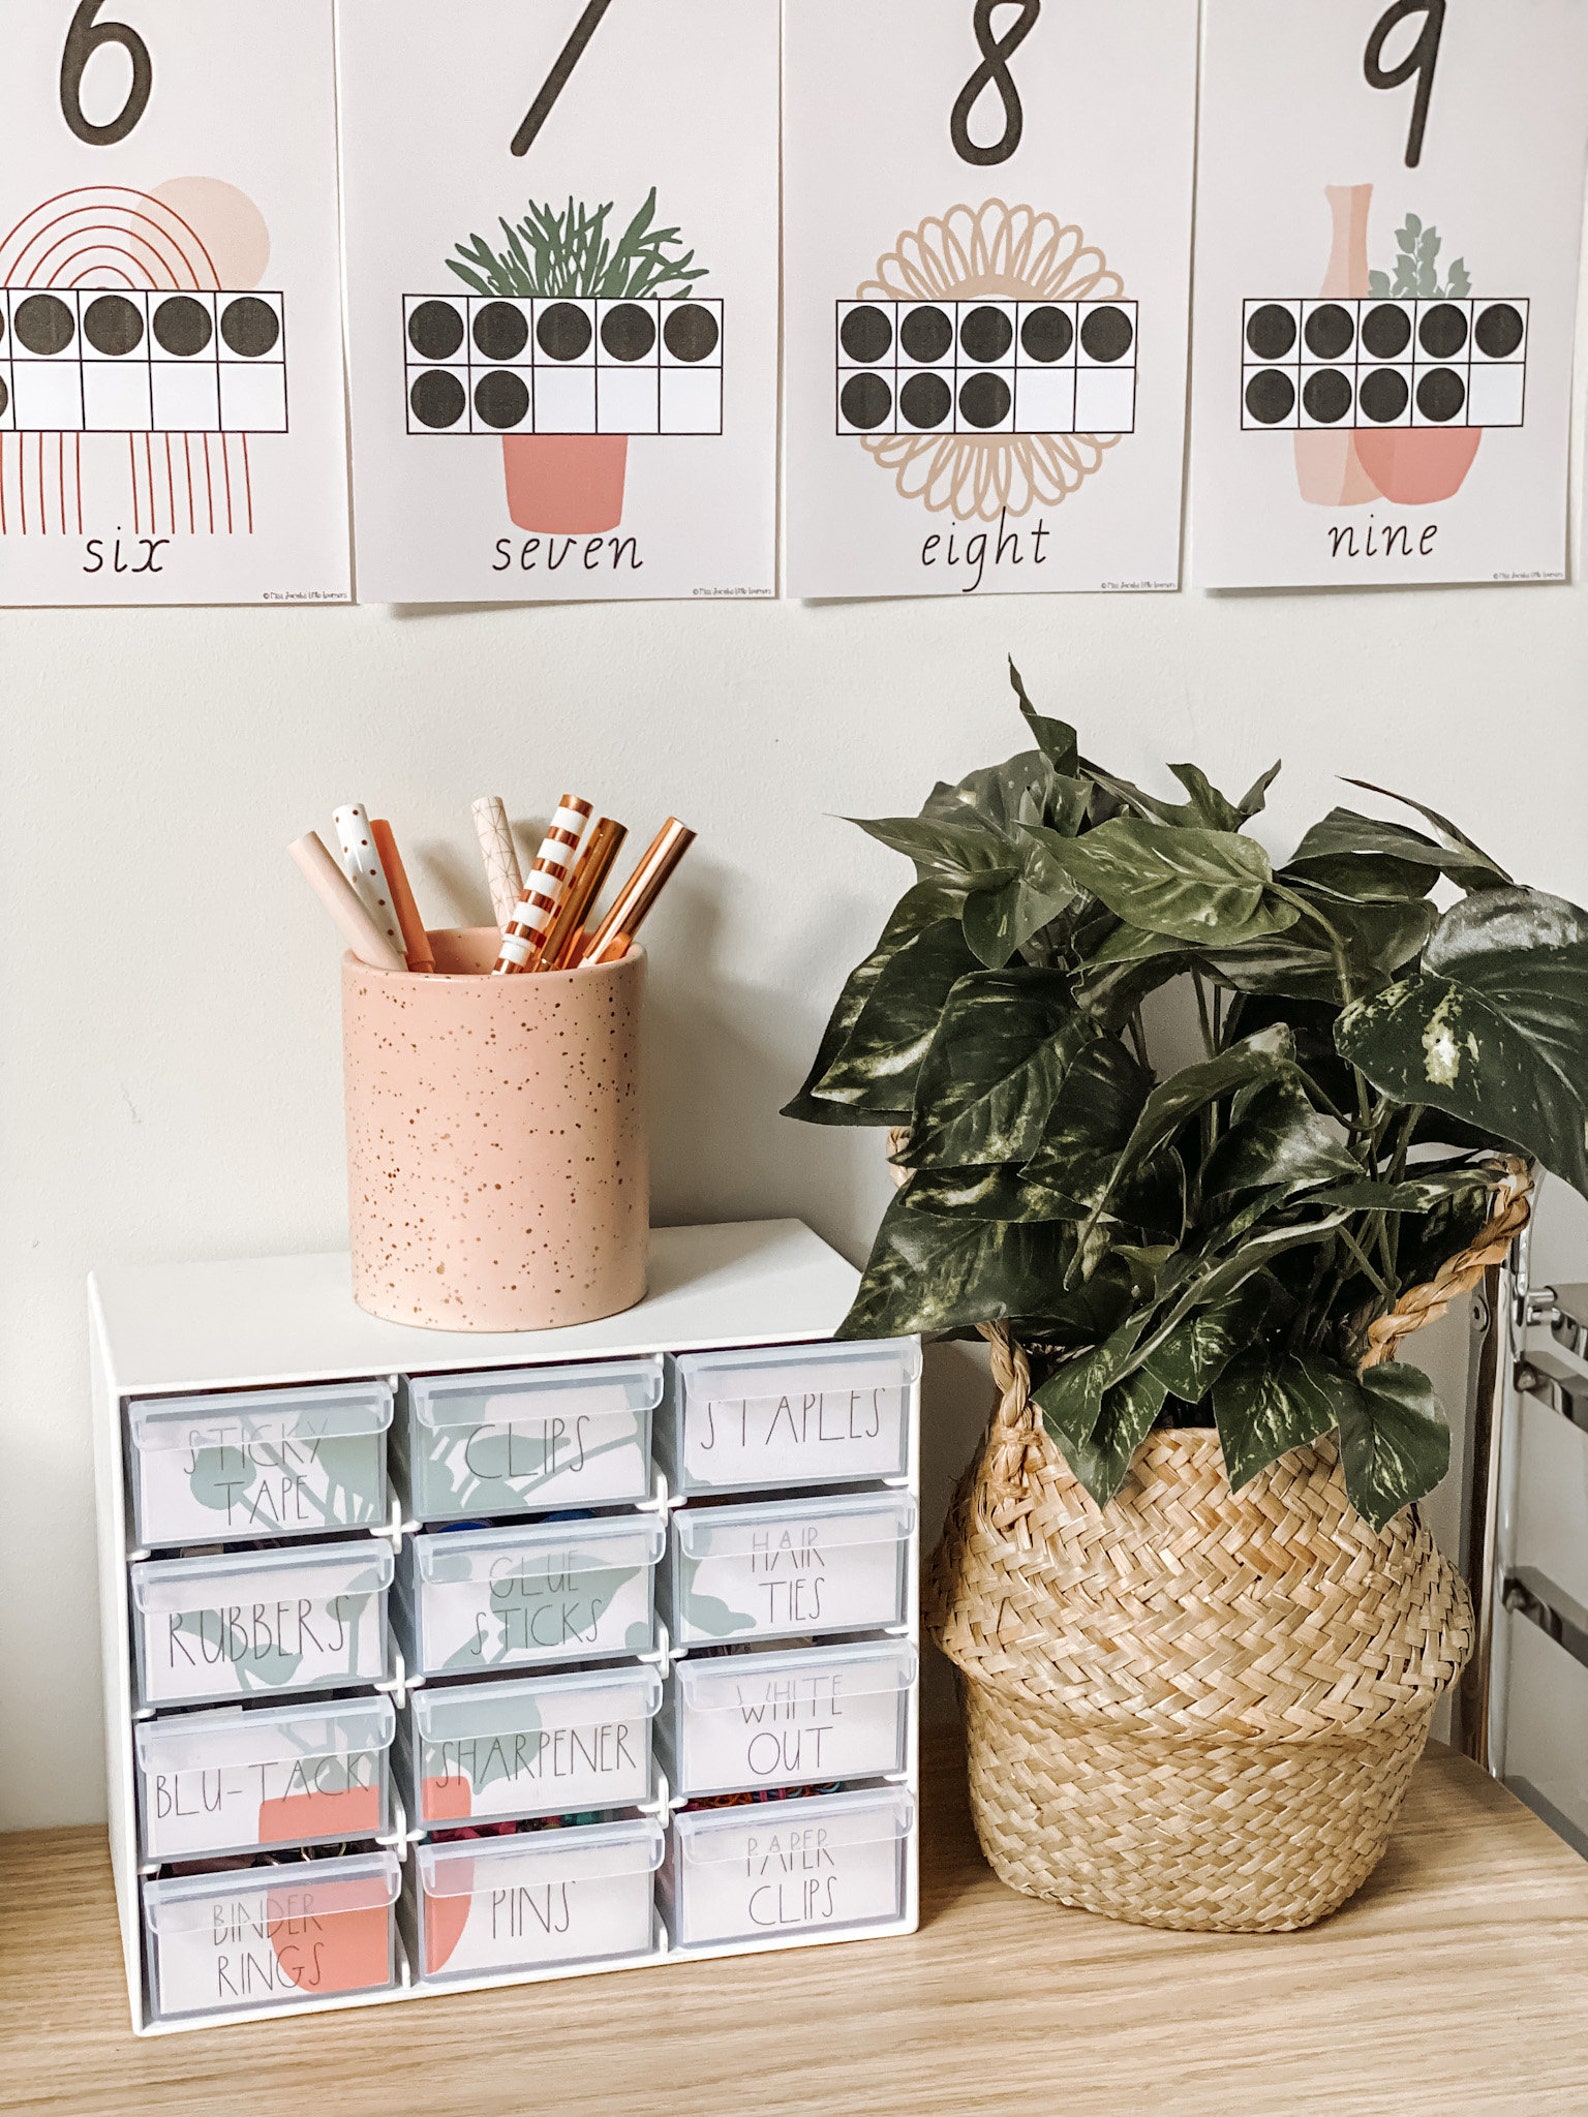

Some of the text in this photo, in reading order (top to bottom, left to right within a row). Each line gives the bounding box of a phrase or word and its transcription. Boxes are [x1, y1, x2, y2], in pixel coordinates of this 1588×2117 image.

[60, 0, 153, 146] 6
[950, 0, 1041, 166] 8
[1363, 0, 1446, 168] 9
[83, 527, 171, 573] six
[492, 534, 645, 571] seven
[921, 506, 1051, 592] eight
[1328, 515, 1439, 559] nine
[184, 1418, 329, 1475] STICKY
[465, 1415, 590, 1479] CLIPS
[214, 1475, 309, 1525] TAPE
[489, 1550, 578, 1599] GLUE
[752, 1527, 825, 1573] HAIR
[758, 1577, 825, 1623] TIES
[169, 1594, 350, 1668] RUBBERS
[471, 1599, 602, 1656] STICKS
[736, 1673, 844, 1724] WHITE
[436, 1724, 637, 1788] SHARPENER
[747, 1726, 834, 1775] OUT
[156, 1755, 369, 1819] BLU-TACK
[747, 1827, 835, 1877] PAPER
[213, 1893, 323, 1946] BINDER
[492, 1880, 577, 1939] PINS
[748, 1876, 838, 1926] CLIPS
[217, 1942, 325, 1997] RINGS
